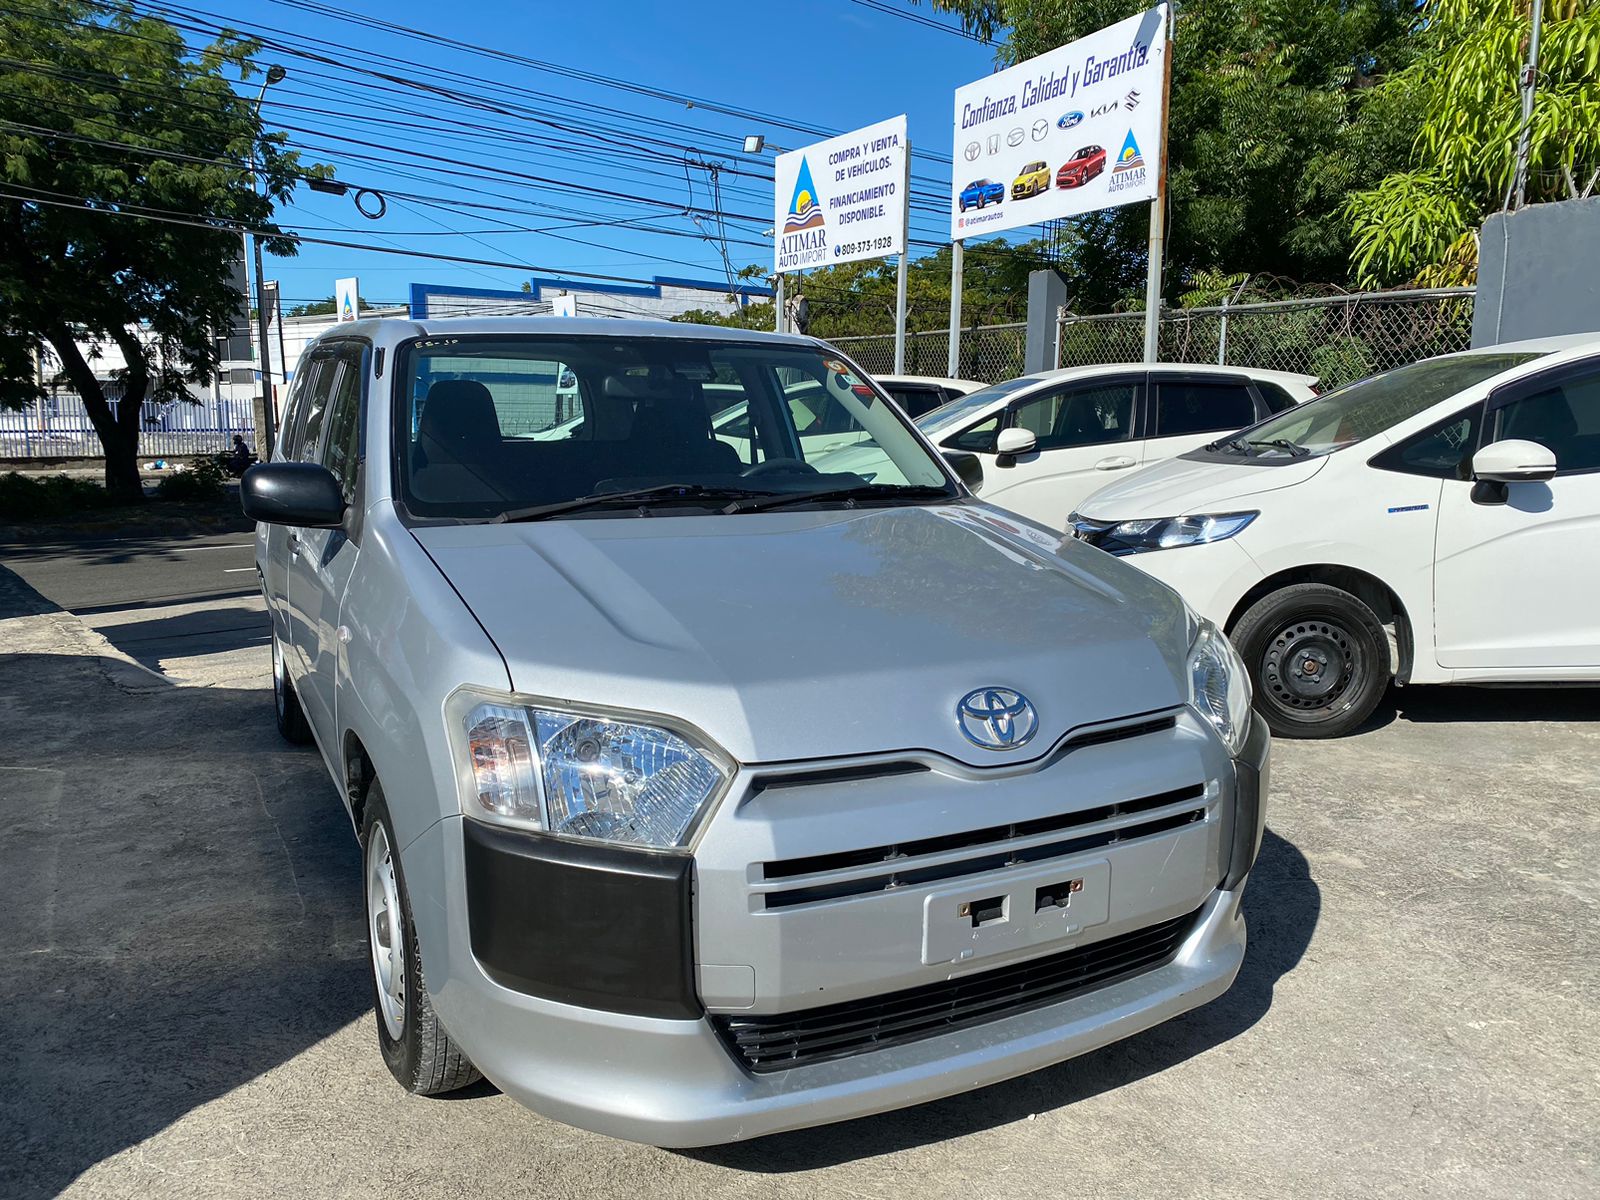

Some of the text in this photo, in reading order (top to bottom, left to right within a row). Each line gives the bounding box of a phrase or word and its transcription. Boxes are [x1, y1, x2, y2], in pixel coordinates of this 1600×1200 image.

[962, 41, 1149, 130] Confianza, Calidad y Garantía.
[1090, 100, 1118, 118] KIA
[828, 134, 898, 166] COMPRA Y VENTA
[835, 155, 892, 182] DE VEHÍCULOS.
[1109, 167, 1146, 185] ATIMAR
[829, 182, 895, 210] FINANCIAMIENTO
[1108, 178, 1146, 193] AUTO IMPORT
[839, 204, 886, 226] DISPONIBLE.
[779, 228, 827, 256] ATIMAR
[841, 235, 892, 256] 809-373-1928
[778, 248, 827, 268] AUTO IMPORT
